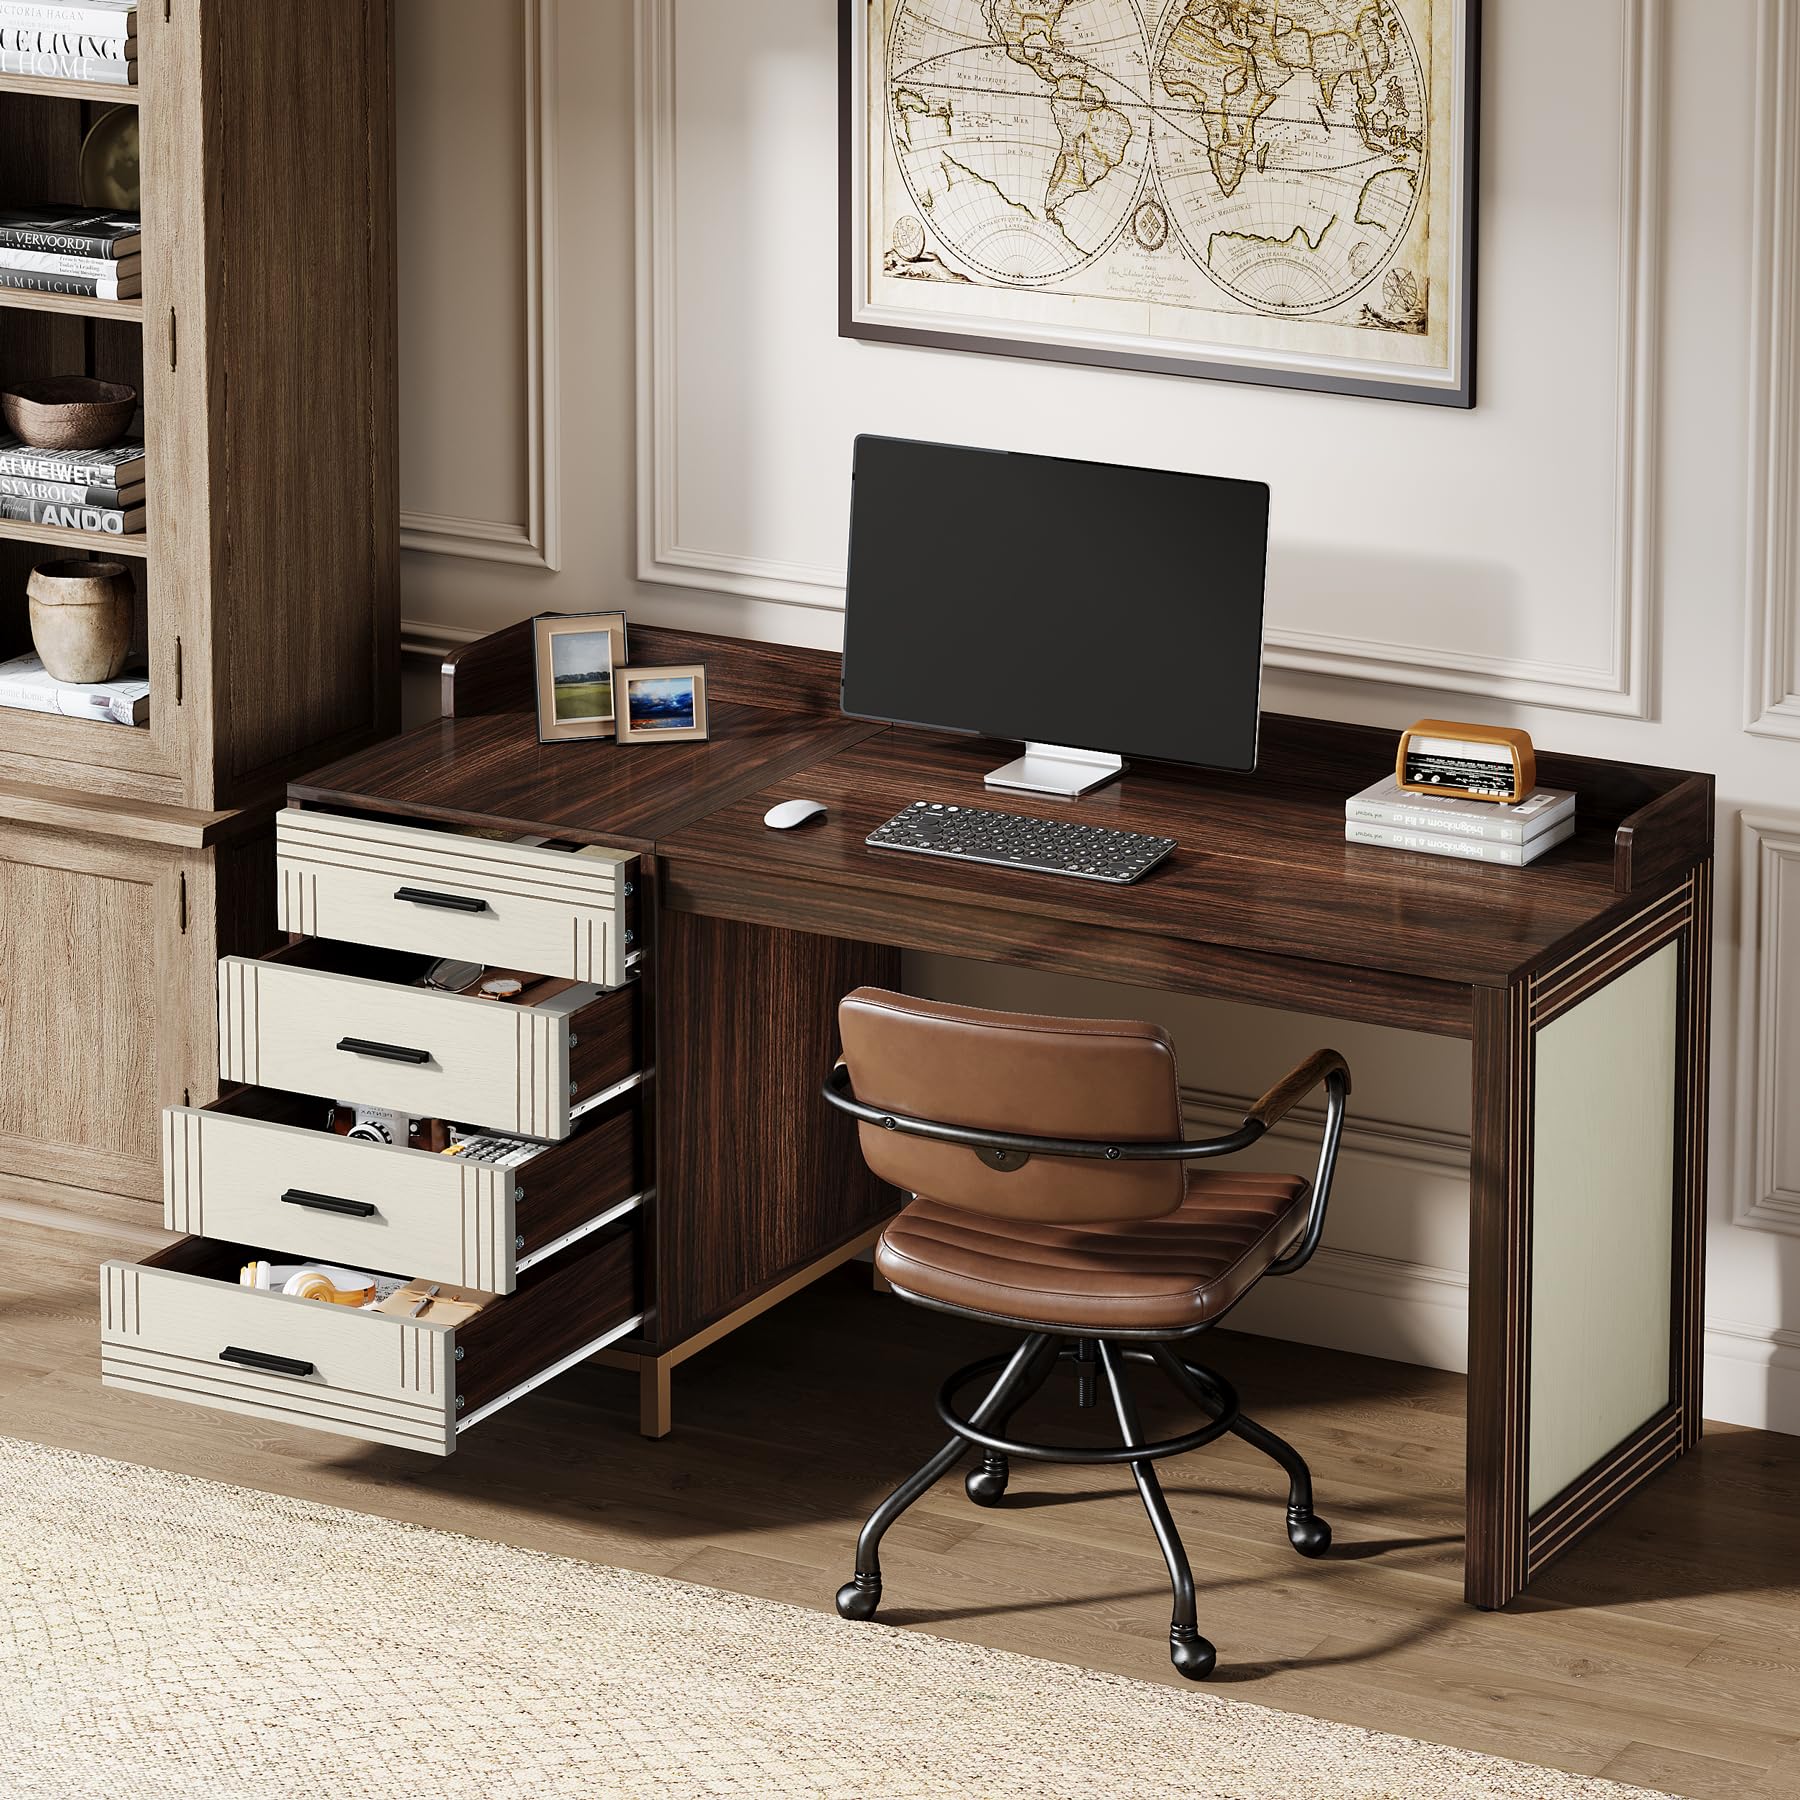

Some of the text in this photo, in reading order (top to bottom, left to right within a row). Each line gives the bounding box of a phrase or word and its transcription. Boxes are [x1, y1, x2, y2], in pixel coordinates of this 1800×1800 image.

[47, 9, 84, 21] HAGAN
[37, 31, 117, 60] LIVING
[18, 51, 95, 81] HOME
[15, 231, 94, 251] VERVOORDT
[0, 275, 93, 296] SIMPLICITY
[1, 478, 81, 504] SYMBOLS
[41, 505, 124, 535] ANDO
